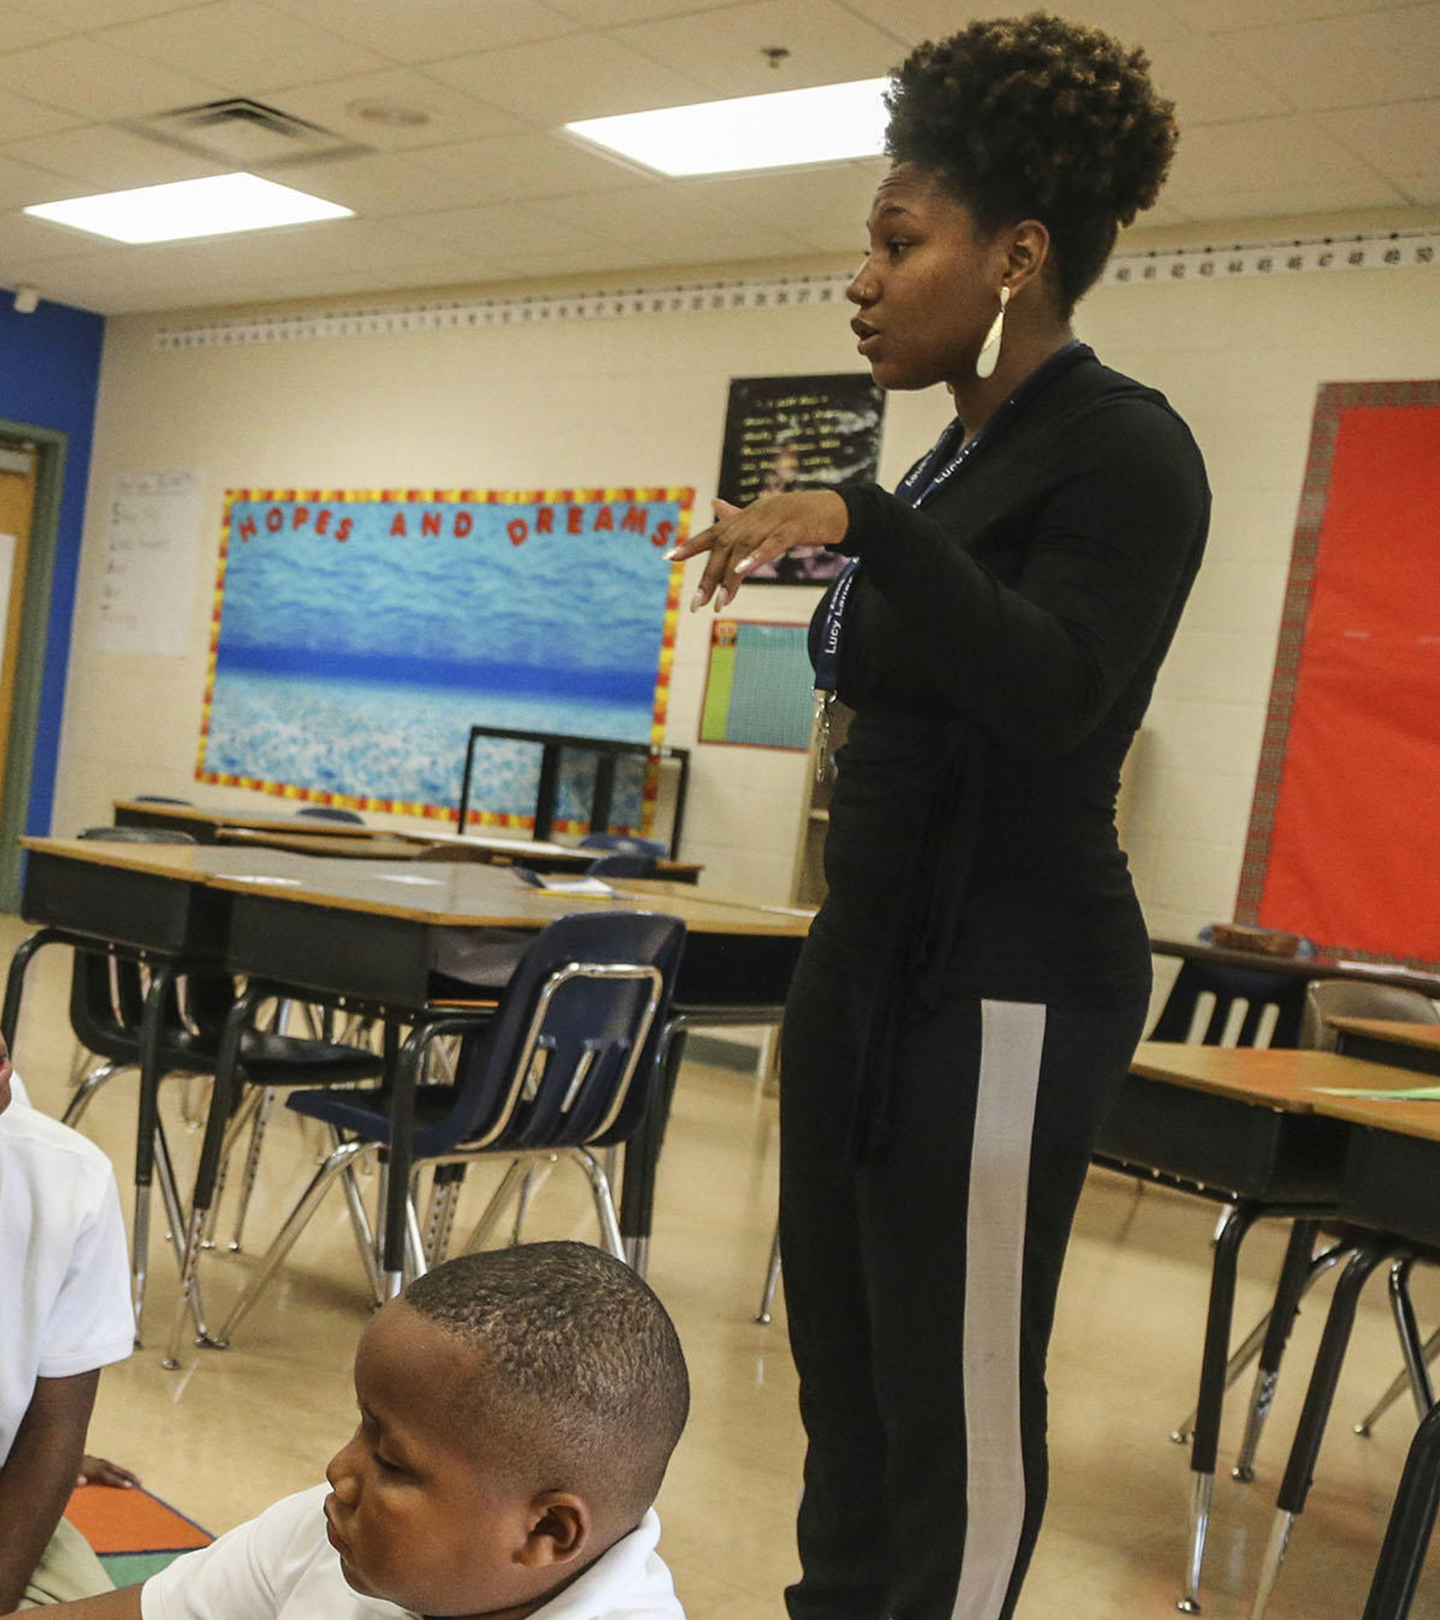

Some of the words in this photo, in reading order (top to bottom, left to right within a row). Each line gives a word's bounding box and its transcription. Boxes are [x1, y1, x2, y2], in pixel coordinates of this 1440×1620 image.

[239, 506, 354, 542] HOPES
[390, 511, 473, 539] AND
[507, 505, 675, 548] DREAMS
[824, 620, 841, 655] Lucy
